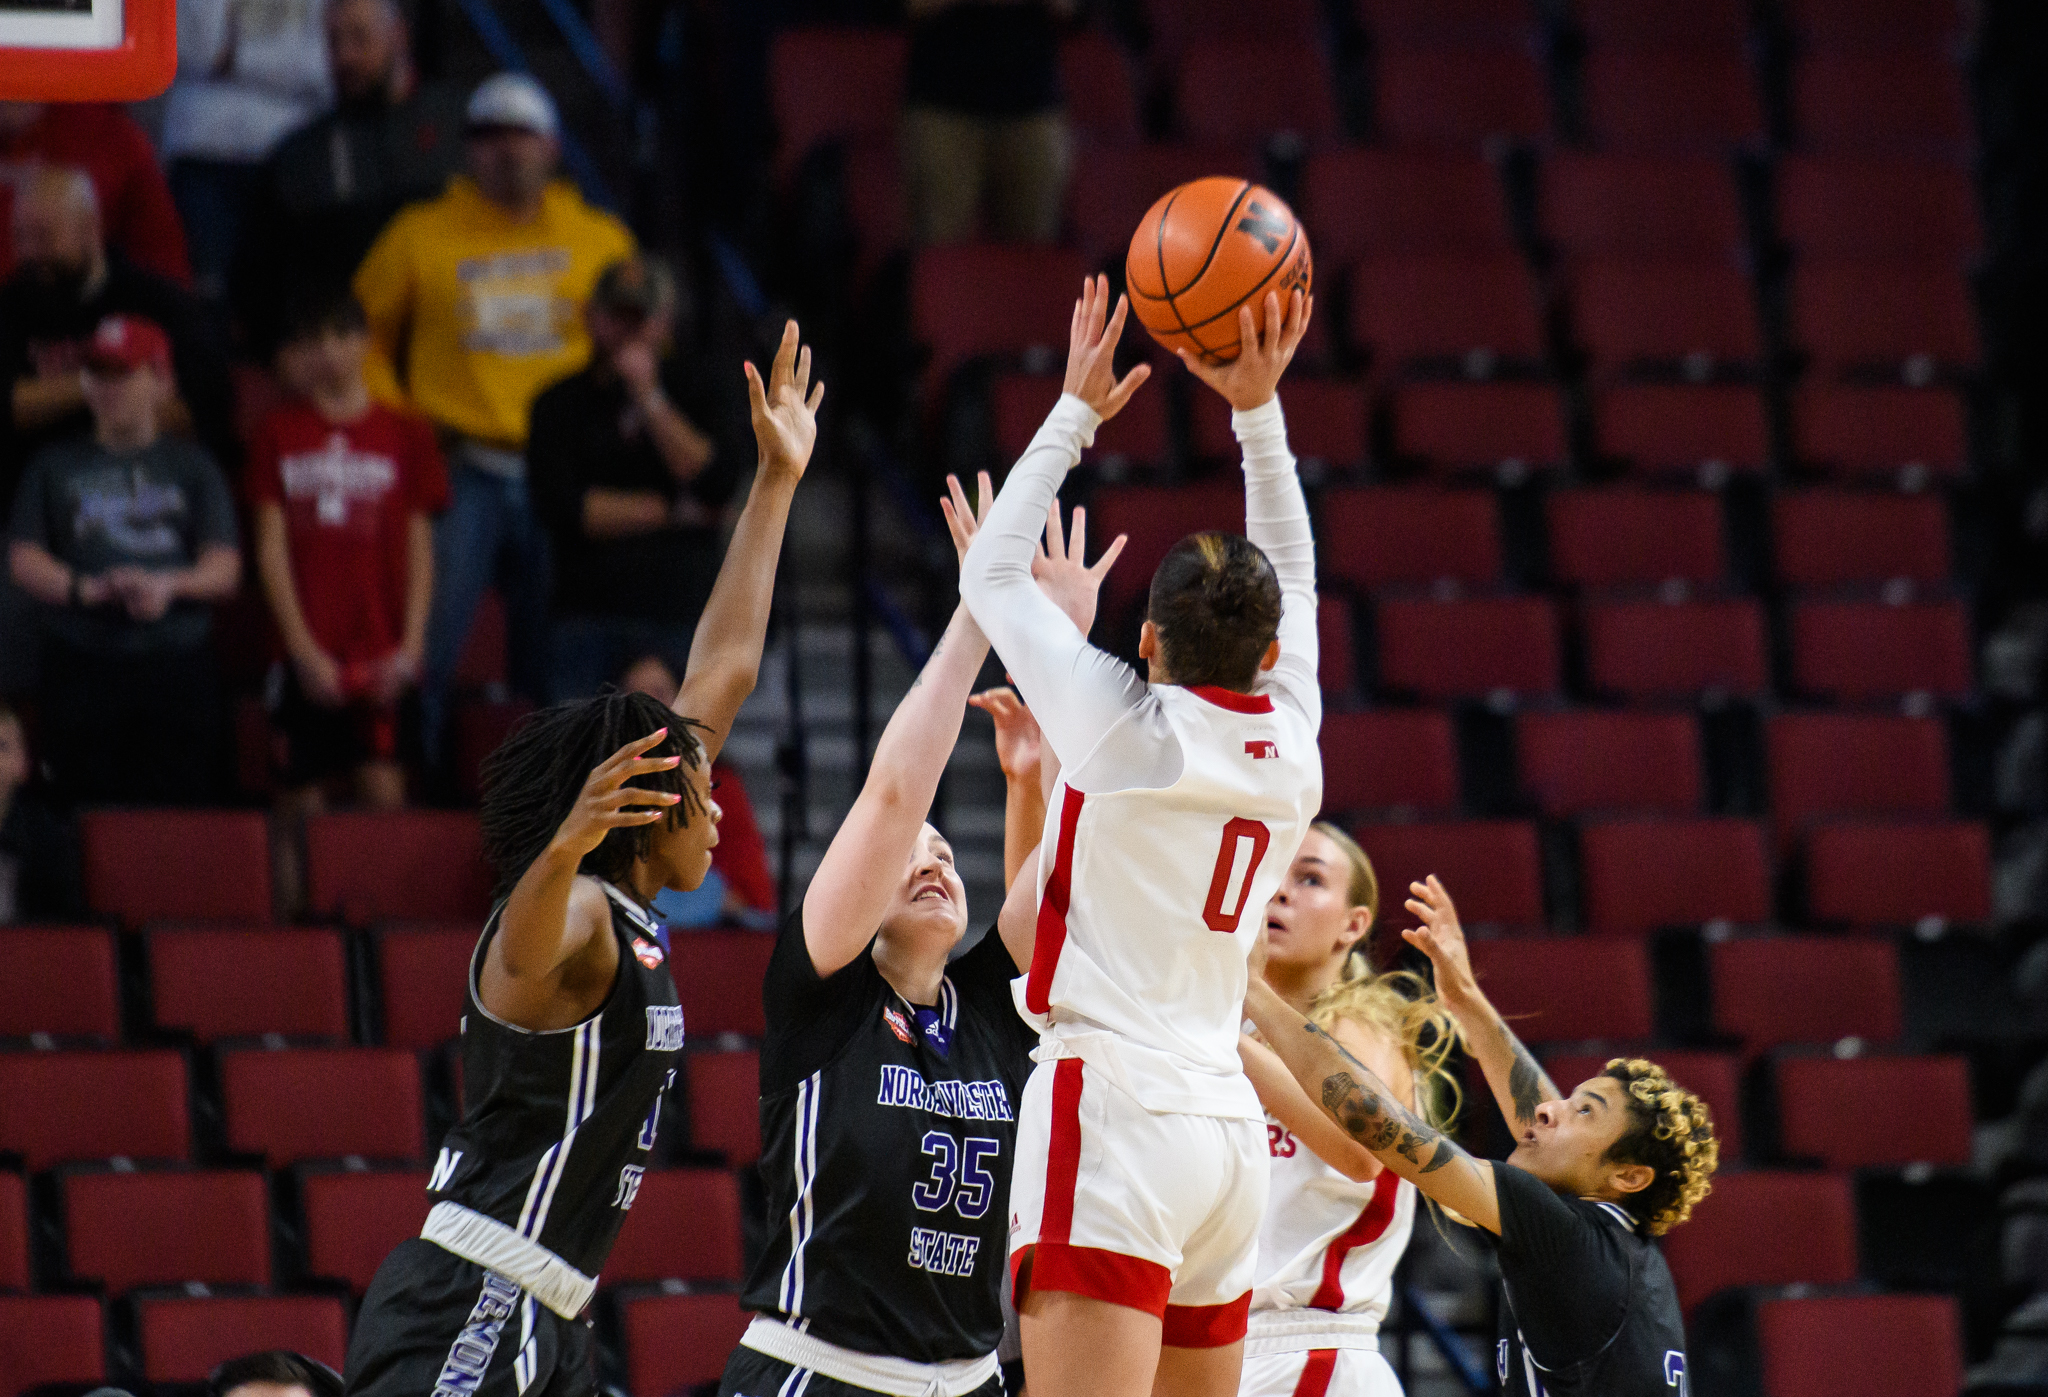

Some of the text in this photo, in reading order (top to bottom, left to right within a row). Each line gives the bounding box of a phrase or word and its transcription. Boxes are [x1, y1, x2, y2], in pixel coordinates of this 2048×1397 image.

[1202, 816, 1271, 934] 0
[912, 1130, 999, 1219] 35
[908, 1226, 981, 1278] STATE
